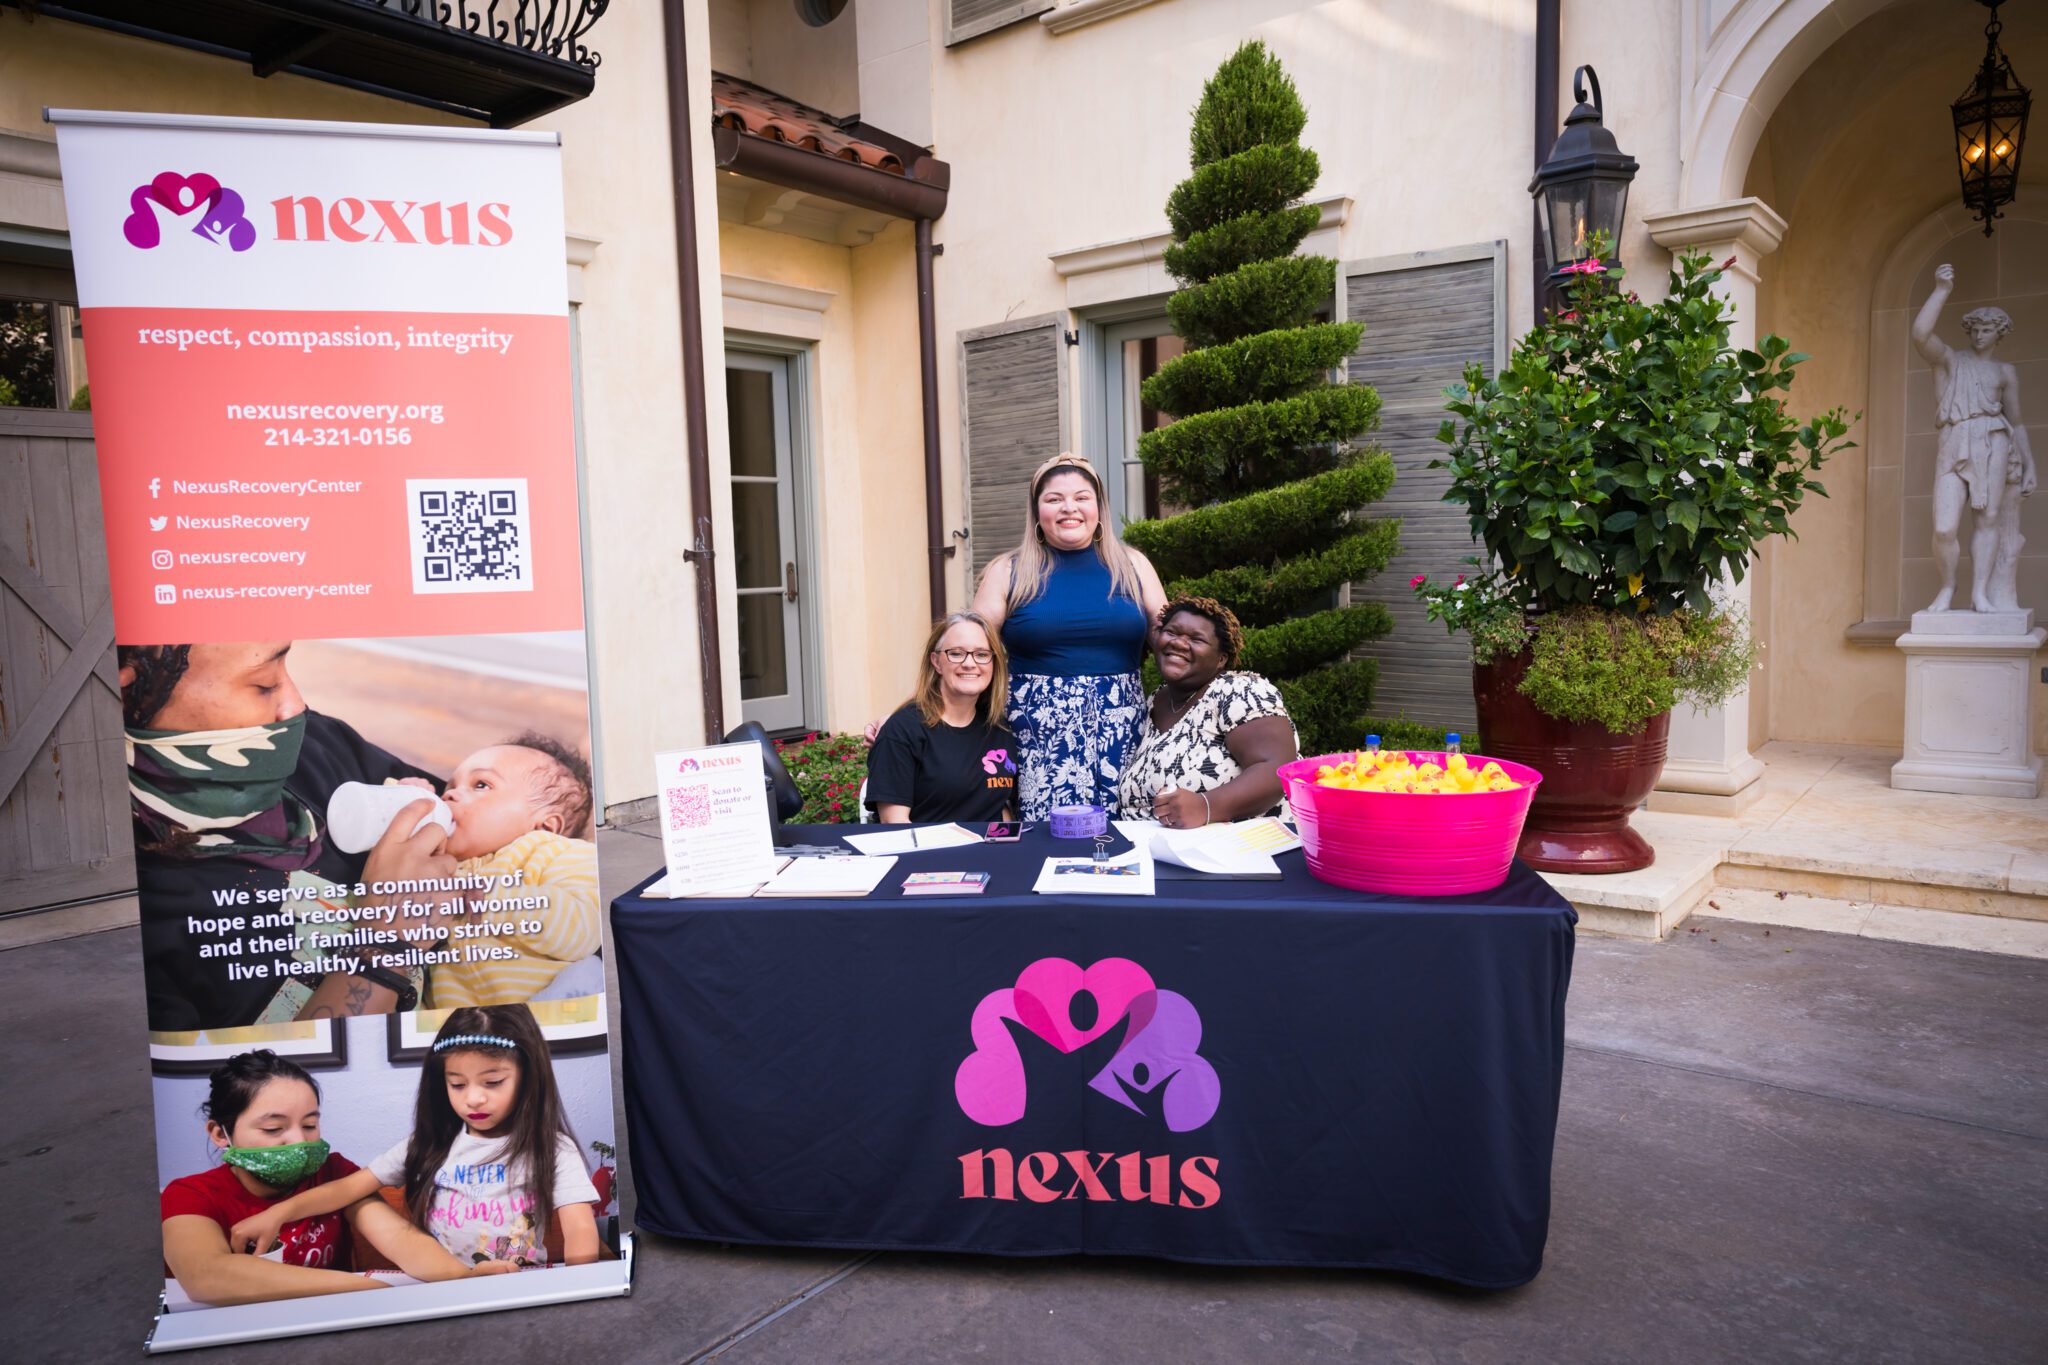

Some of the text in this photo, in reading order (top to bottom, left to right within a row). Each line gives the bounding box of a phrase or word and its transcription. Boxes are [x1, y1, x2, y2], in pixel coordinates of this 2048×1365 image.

[269, 195, 513, 247] nexus
[138, 326, 514, 354] respect, compassion, integrity
[227, 402, 444, 424] nexusrecovery.org
[264, 427, 412, 446] 214-321-0156
[173, 479, 363, 497] NexusRecoveryCenter
[176, 515, 310, 531] NexusRecovery
[179, 551, 306, 566] nexusrecovery
[182, 582, 372, 600] nexus-recovery-center
[701, 756, 742, 768] nexus
[212, 869, 523, 907] We serve as a community of
[187, 895, 549, 937] hope and recovery for all women
[199, 919, 542, 958] and their families who strive to
[228, 944, 519, 981] live healthy, resilient lives.
[454, 1163, 506, 1185] NEVER
[957, 1147, 1222, 1209] nexus
